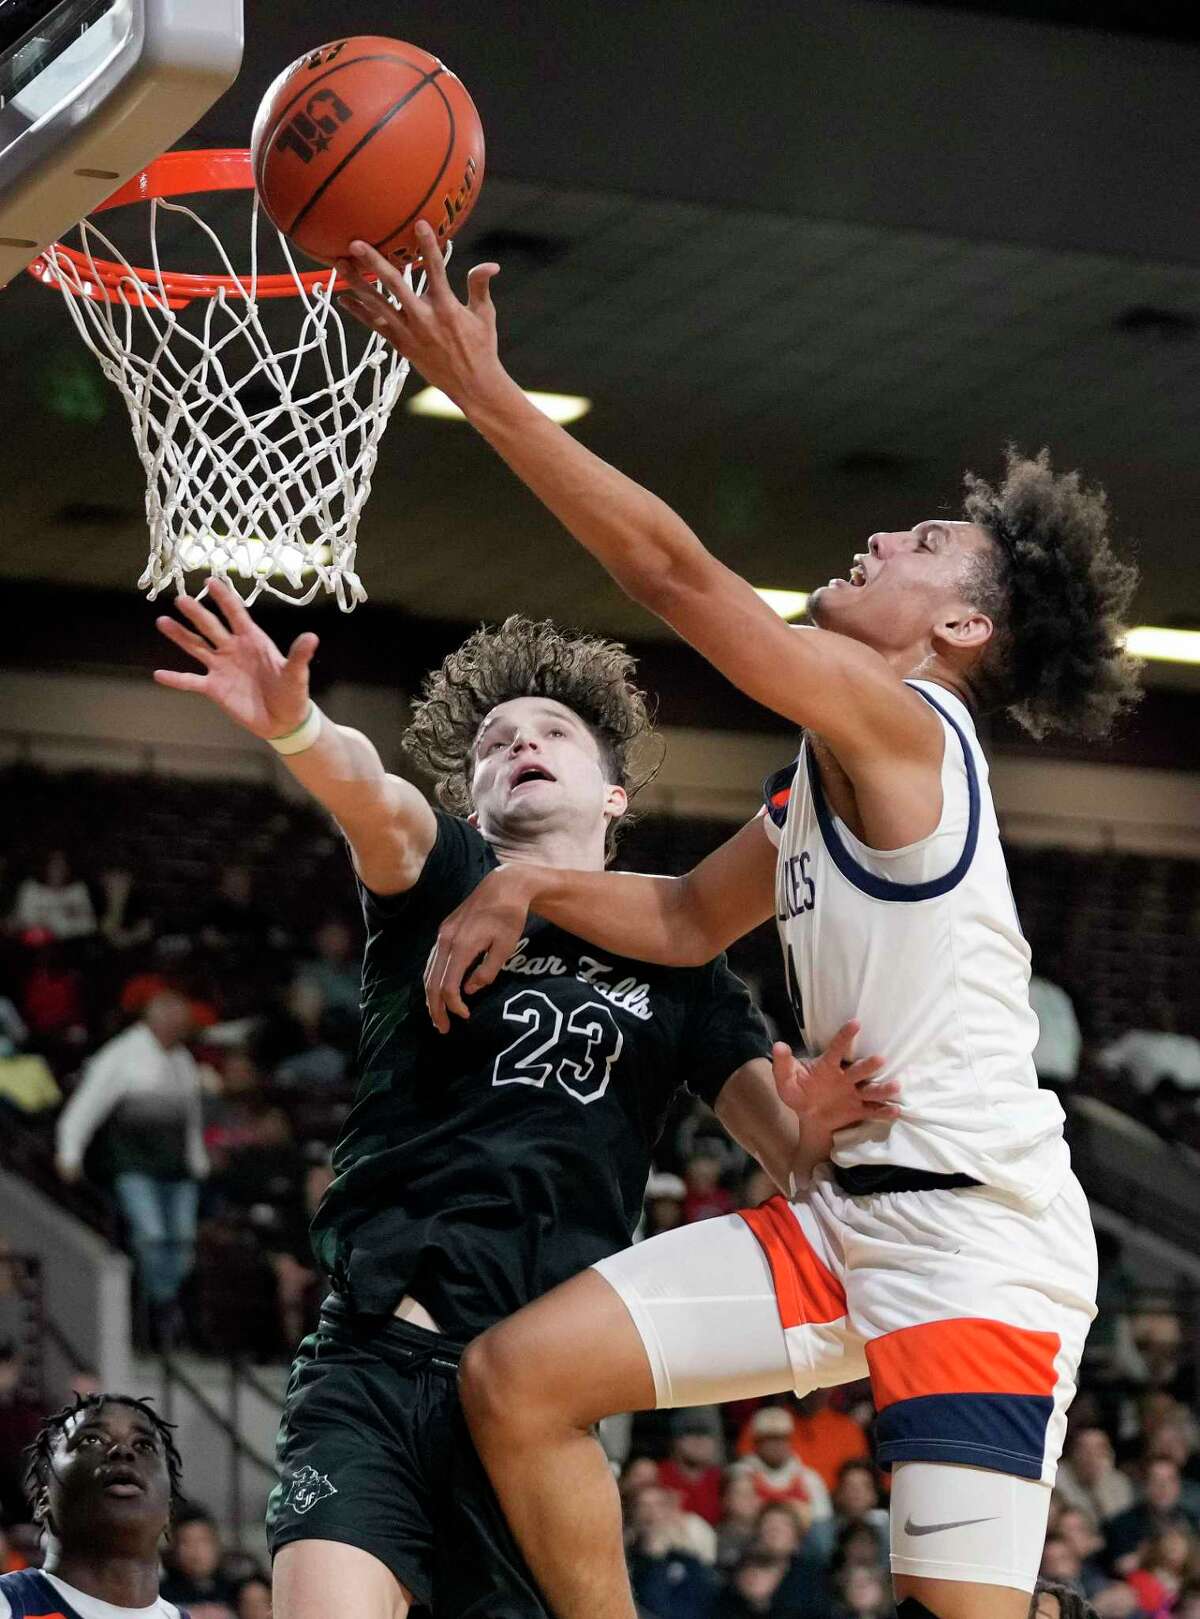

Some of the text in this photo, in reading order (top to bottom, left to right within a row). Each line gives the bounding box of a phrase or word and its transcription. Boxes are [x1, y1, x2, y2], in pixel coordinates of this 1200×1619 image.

[501, 937, 653, 1020] lear Falls
[492, 989, 624, 1104] 23
